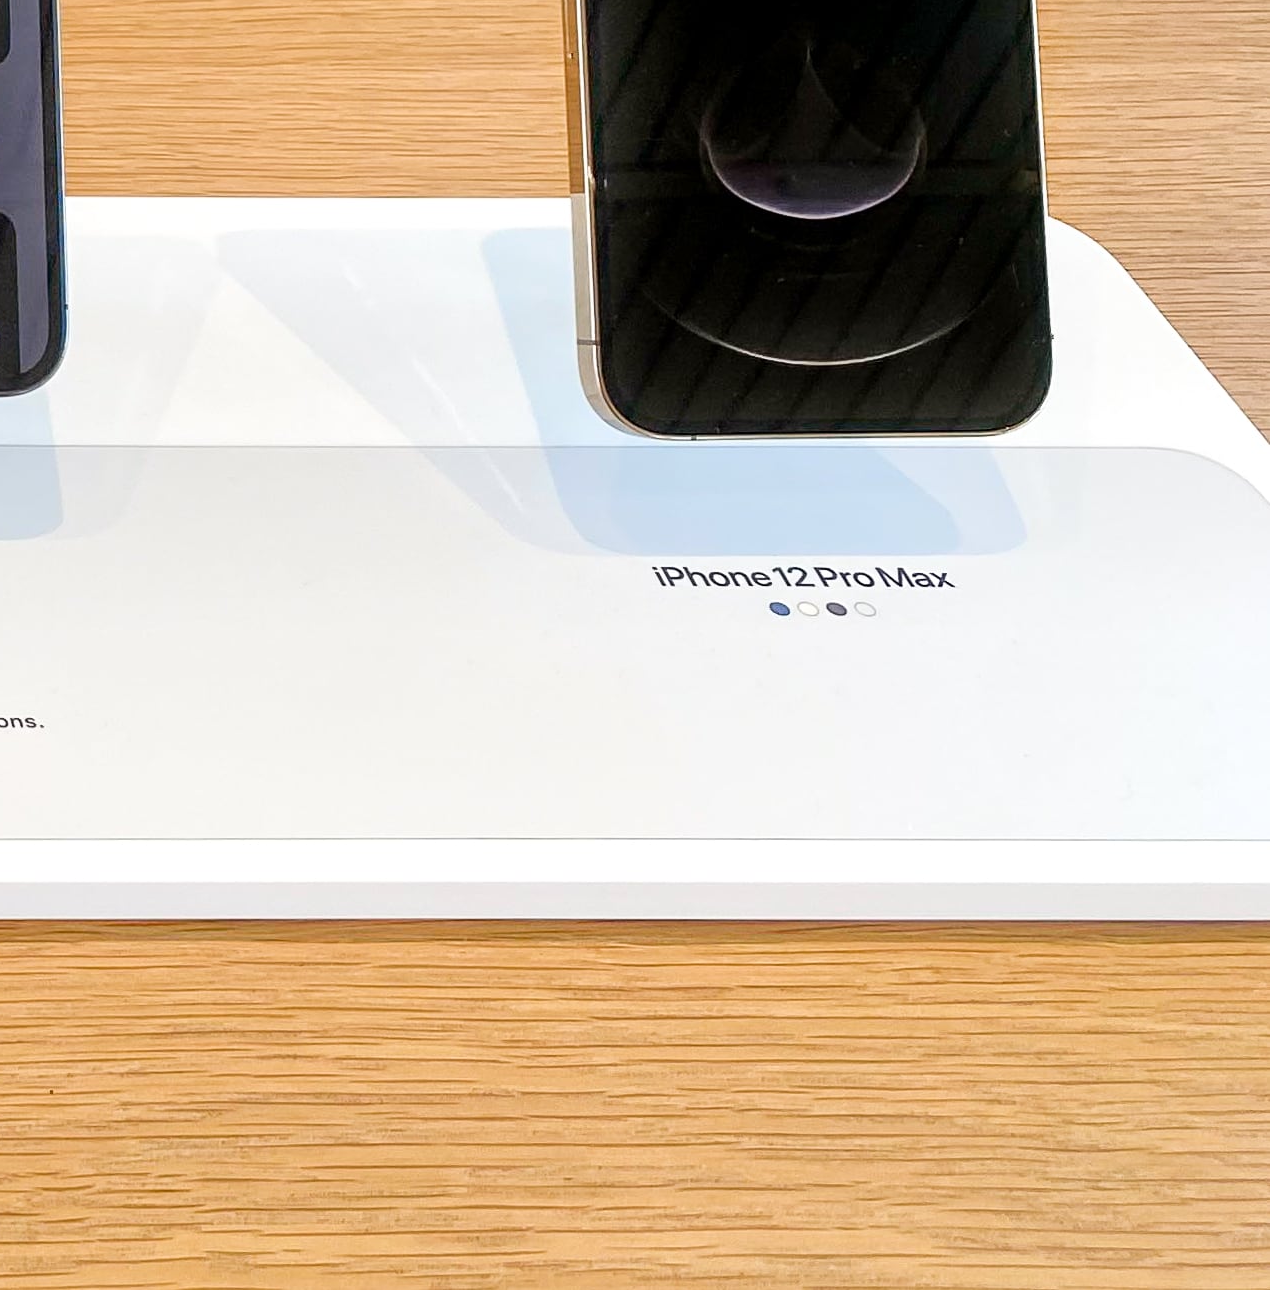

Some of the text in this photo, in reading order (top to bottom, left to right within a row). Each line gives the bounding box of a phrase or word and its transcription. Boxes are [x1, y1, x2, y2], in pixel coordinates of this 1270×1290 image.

[652, 567, 955, 587] iPhone 12 Pro Max
